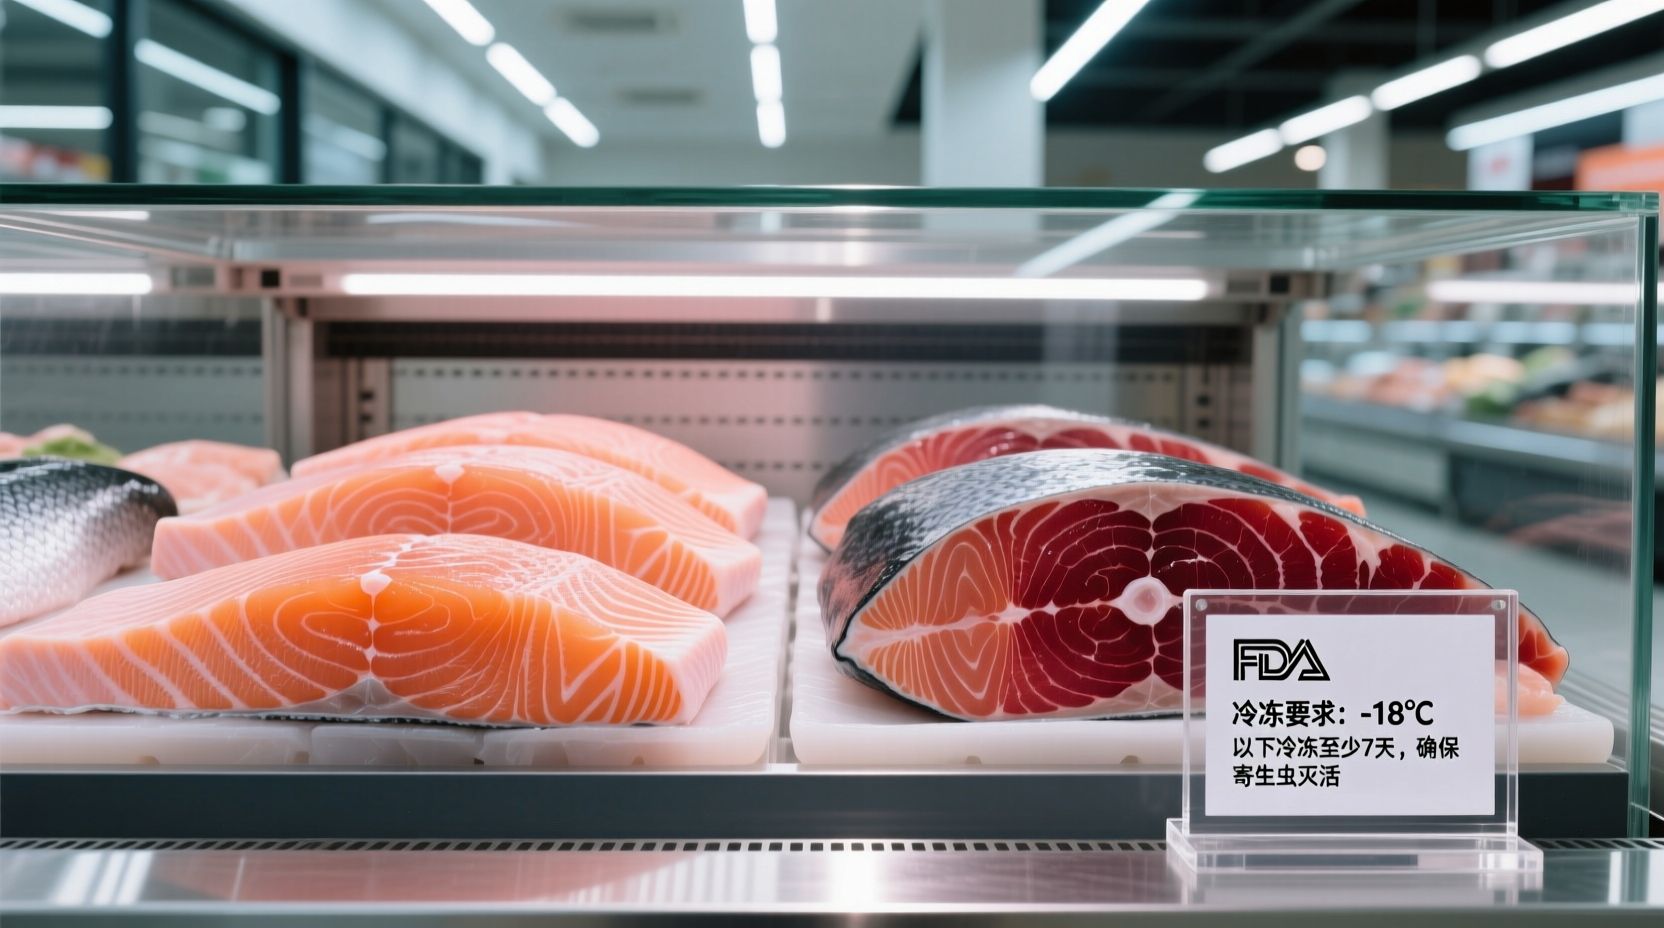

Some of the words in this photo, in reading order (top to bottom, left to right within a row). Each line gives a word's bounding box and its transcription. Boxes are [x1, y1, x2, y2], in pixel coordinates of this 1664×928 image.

[1233, 638, 1331, 682] FDA
[1233, 734, 1460, 761] 以下冷冻至少7天，确保
[1232, 763, 1341, 788] 寄生虫灭活
